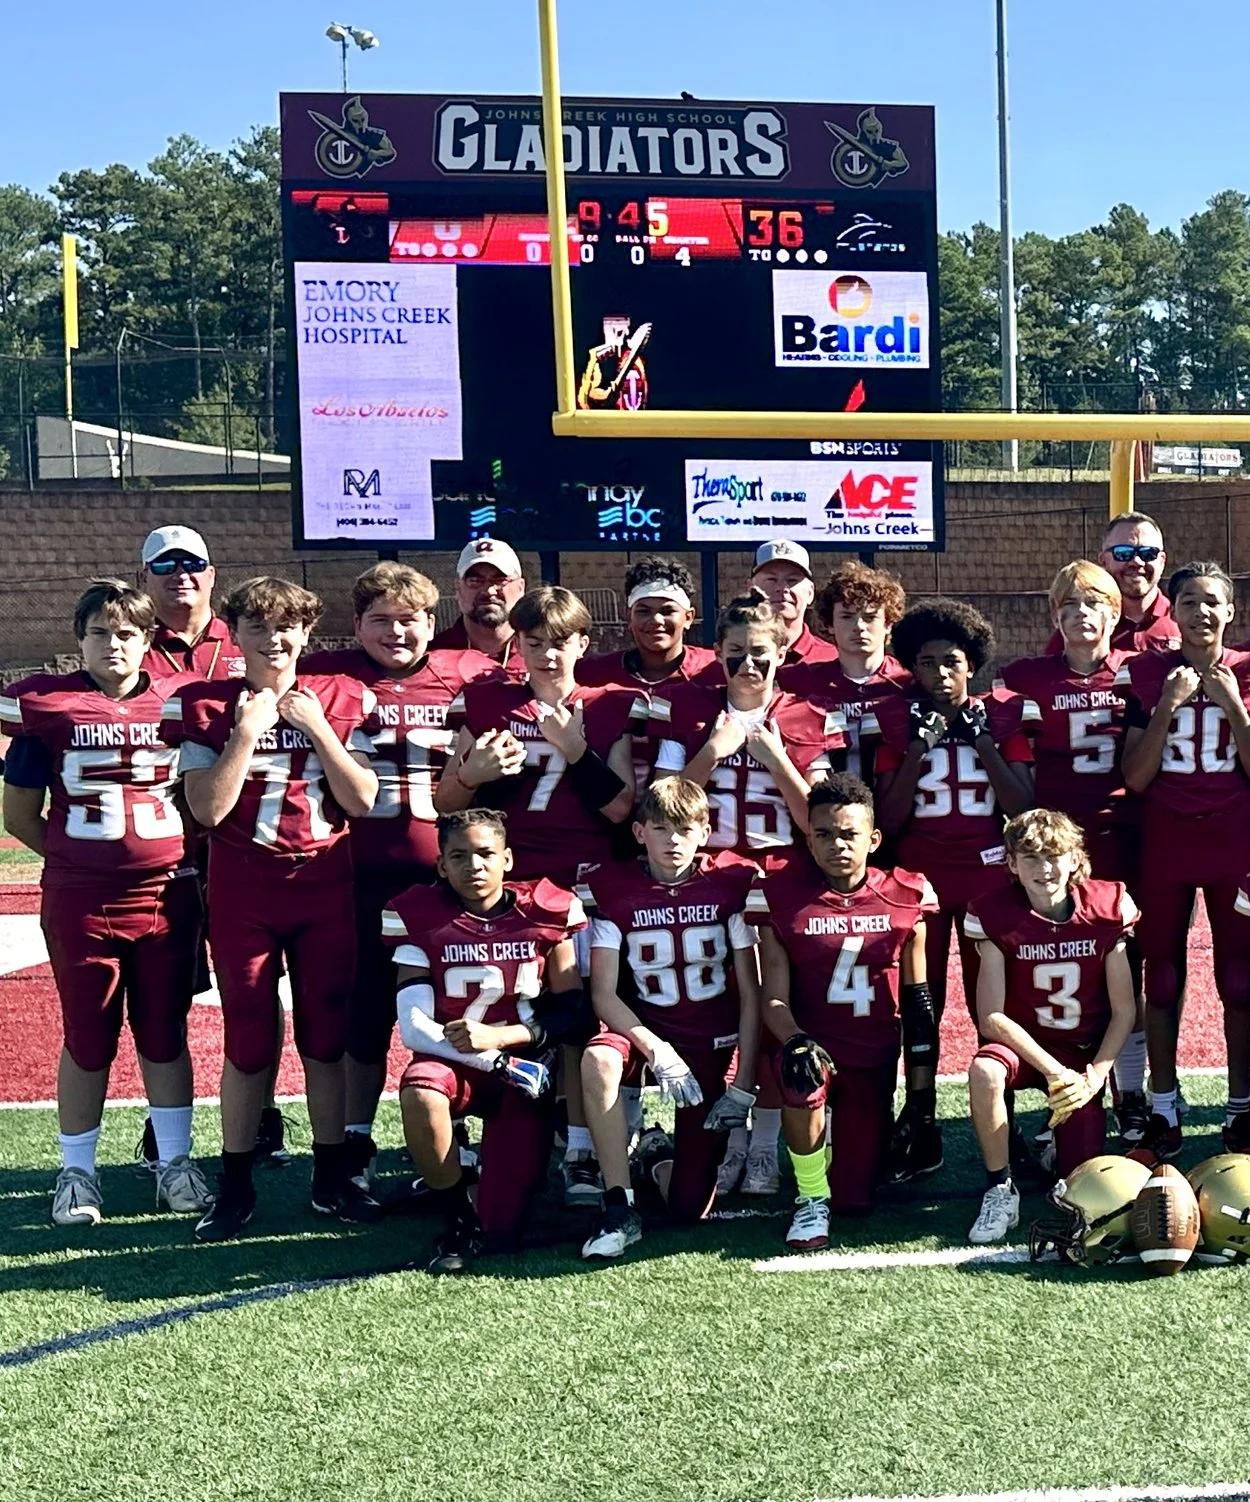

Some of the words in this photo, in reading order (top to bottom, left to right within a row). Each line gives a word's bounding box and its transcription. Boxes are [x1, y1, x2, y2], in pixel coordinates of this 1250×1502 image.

[485, 110, 541, 120] JOHNS
[563, 111, 607, 121] REEK
[616, 112, 657, 122] HIGH
[667, 113, 736, 124] SCHOOL
[438, 105, 785, 176] GLADIATORS
[749, 210, 803, 247] 36
[580, 244, 594, 263] 0
[631, 246, 644, 265] 0
[675, 247, 691, 266] 4
[749, 250, 771, 261] TO
[303, 280, 399, 302] EMORY
[303, 306, 377, 323] JOHNS
[382, 307, 452, 324] CREEK
[304, 327, 408, 344] HOSPITAL
[782, 313, 920, 353] Bardi
[824, 469, 919, 510] ACE
[825, 522, 870, 535] Johns
[875, 522, 919, 535] Creek
[1052, 693, 1088, 710] JOHNS
[71, 723, 125, 747] JOHNS
[129, 722, 165, 746] CRE
[1069, 709, 1116, 774] 5
[523, 741, 567, 811] 7
[60, 749, 184, 840] 53
[246, 752, 334, 846] 71
[632, 907, 675, 928] JOHNS
[679, 904, 721, 923] CREEK
[804, 916, 849, 935] JOHNS
[852, 914, 891, 933] CREEK
[441, 944, 489, 963] JOHNS
[493, 941, 537, 961] CREEK
[1016, 943, 1057, 960] JOHNS
[1059, 939, 1097, 959] CREEK
[626, 924, 727, 1007] 88
[827, 936, 875, 1018] 4
[1032, 962, 1081, 1030] 3
